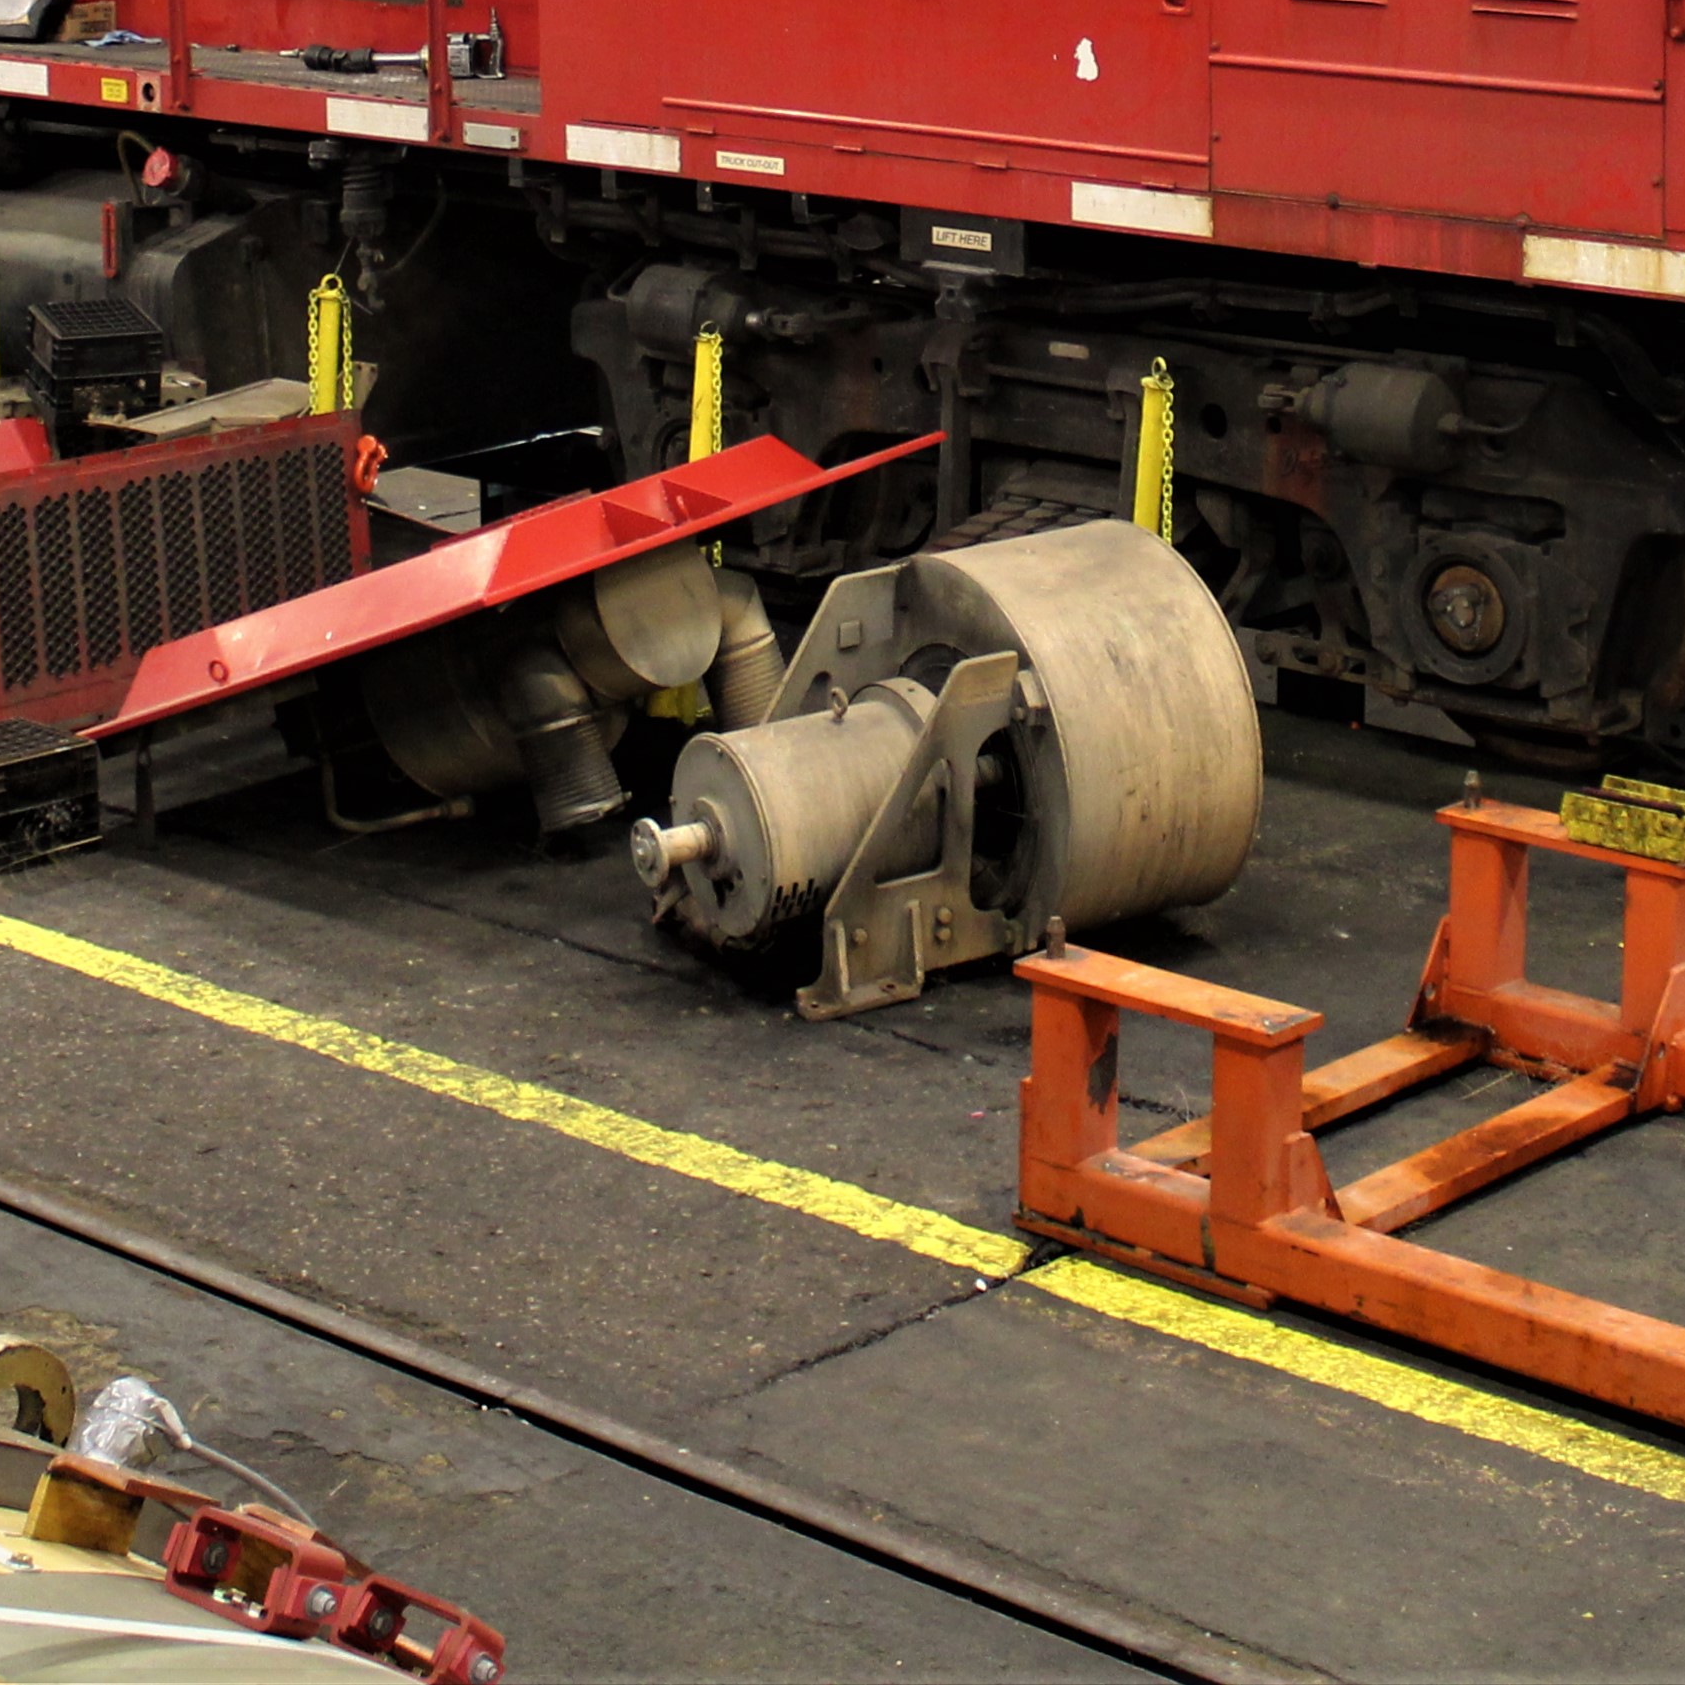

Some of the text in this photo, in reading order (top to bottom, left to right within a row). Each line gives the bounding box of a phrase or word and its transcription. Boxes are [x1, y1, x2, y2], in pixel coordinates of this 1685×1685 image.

[720, 155, 745, 166] TRUCK
[936, 230, 988, 247] LIFT HERE
